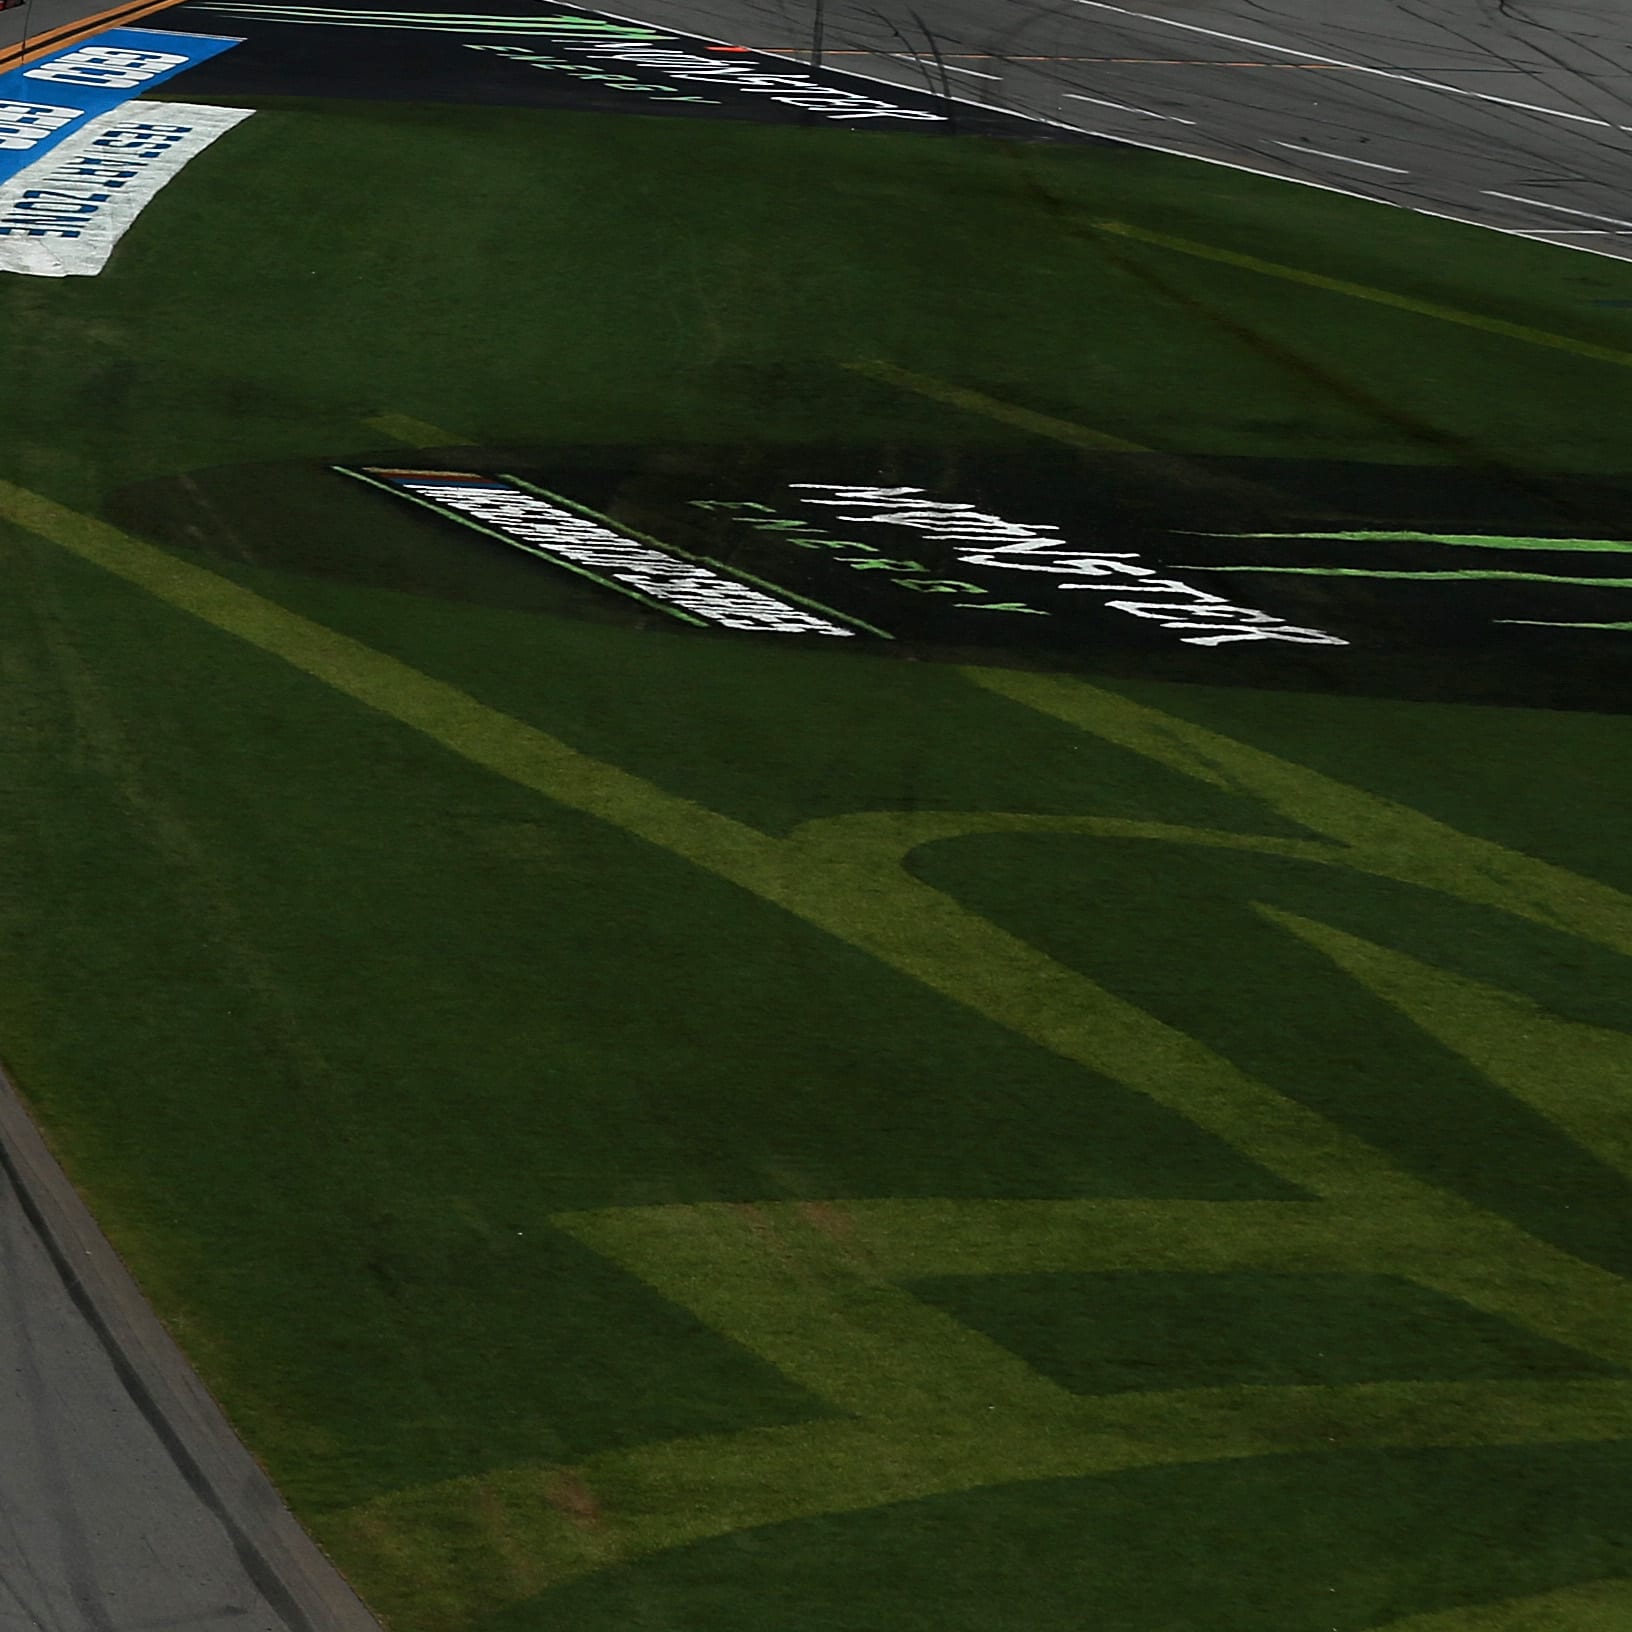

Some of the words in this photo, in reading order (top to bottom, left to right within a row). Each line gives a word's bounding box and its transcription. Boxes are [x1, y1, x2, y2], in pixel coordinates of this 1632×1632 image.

[23, 46, 191, 89] GEICO
[42, 122, 193, 188] RESTART
[686, 499, 1052, 615] ENERGY
